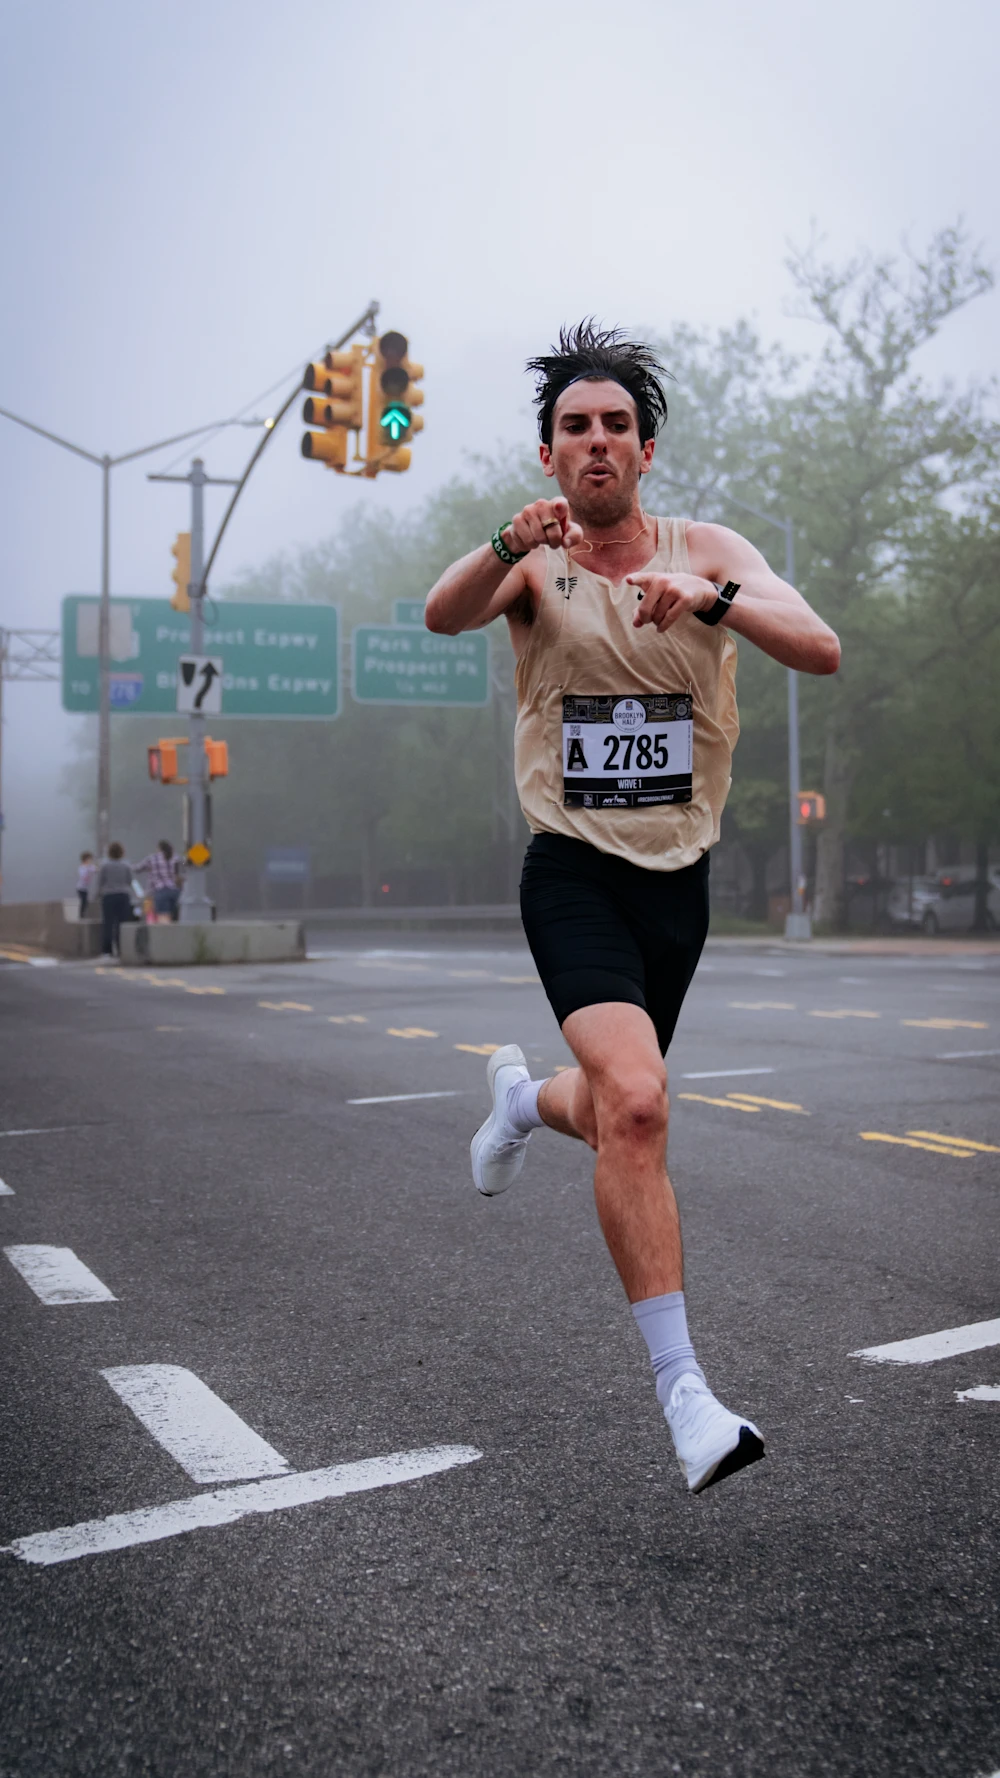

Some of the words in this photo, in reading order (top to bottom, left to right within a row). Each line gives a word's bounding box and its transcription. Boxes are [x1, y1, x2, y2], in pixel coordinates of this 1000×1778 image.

[156, 627, 245, 646] Propect
[254, 629, 318, 649] Expwy
[367, 636, 411, 653] Park
[268, 673, 332, 697] Expwy
[567, 738, 588, 770] A
[603, 734, 668, 770] 2785
[617, 779, 637, 789] WAVE
[638, 779, 642, 789] 1
